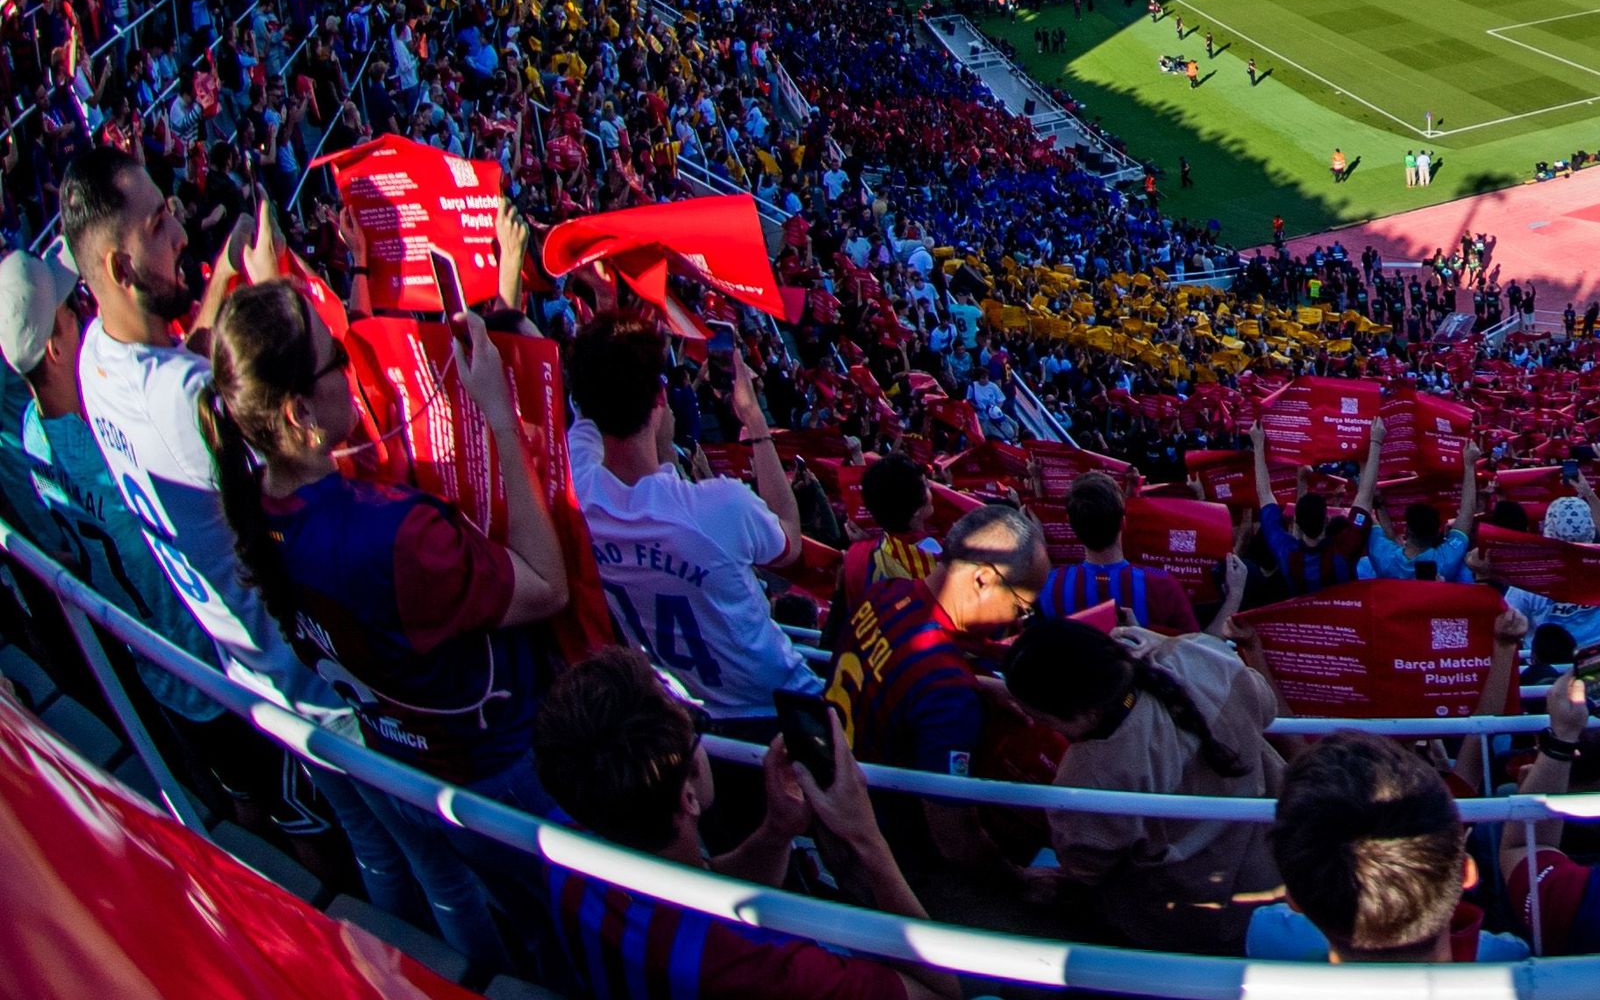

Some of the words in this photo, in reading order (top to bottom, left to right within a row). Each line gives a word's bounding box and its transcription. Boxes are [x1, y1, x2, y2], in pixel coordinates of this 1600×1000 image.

[439, 196, 465, 212] Barça
[467, 194, 500, 209] Matchd
[461, 214, 493, 230] Playlist
[542, 361, 552, 380] FC
[543, 385, 556, 455] Barcelona
[1344, 416, 1372, 425] Matchda
[1337, 425, 1362, 434] Playlist
[95, 417, 138, 468] PEDRI
[636, 543, 710, 588] FÉLIX
[1164, 564, 1202, 574] Playlist
[1333, 600, 1362, 608] Madrid
[850, 600, 893, 683] PUYOL
[1394, 659, 1436, 673] Barça
[1439, 656, 1492, 669] Matchd
[1424, 672, 1478, 686] Playlist
[379, 722, 429, 751] UNHCR
